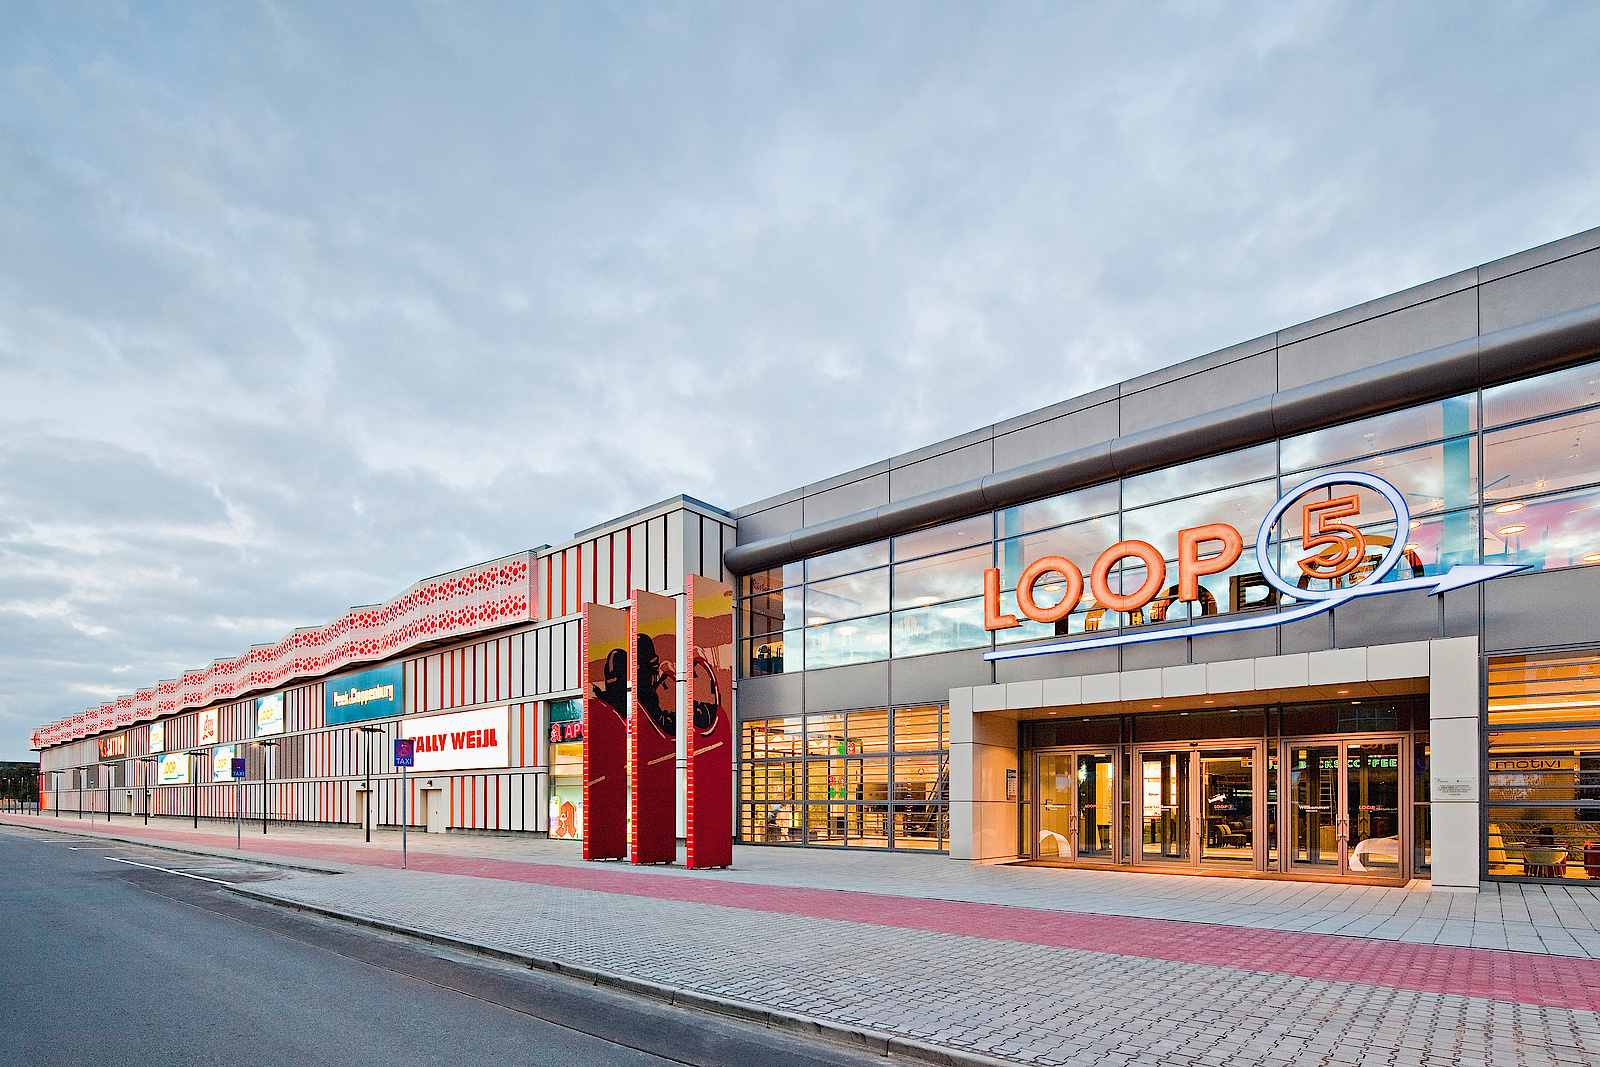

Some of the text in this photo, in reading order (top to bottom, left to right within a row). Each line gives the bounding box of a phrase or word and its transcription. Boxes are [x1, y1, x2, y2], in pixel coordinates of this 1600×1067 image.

[984, 494, 1366, 632] LOOP 5
[409, 733, 447, 753] ALLY
[396, 757, 412, 765] TAXI
[1495, 760, 1561, 769] motivi
